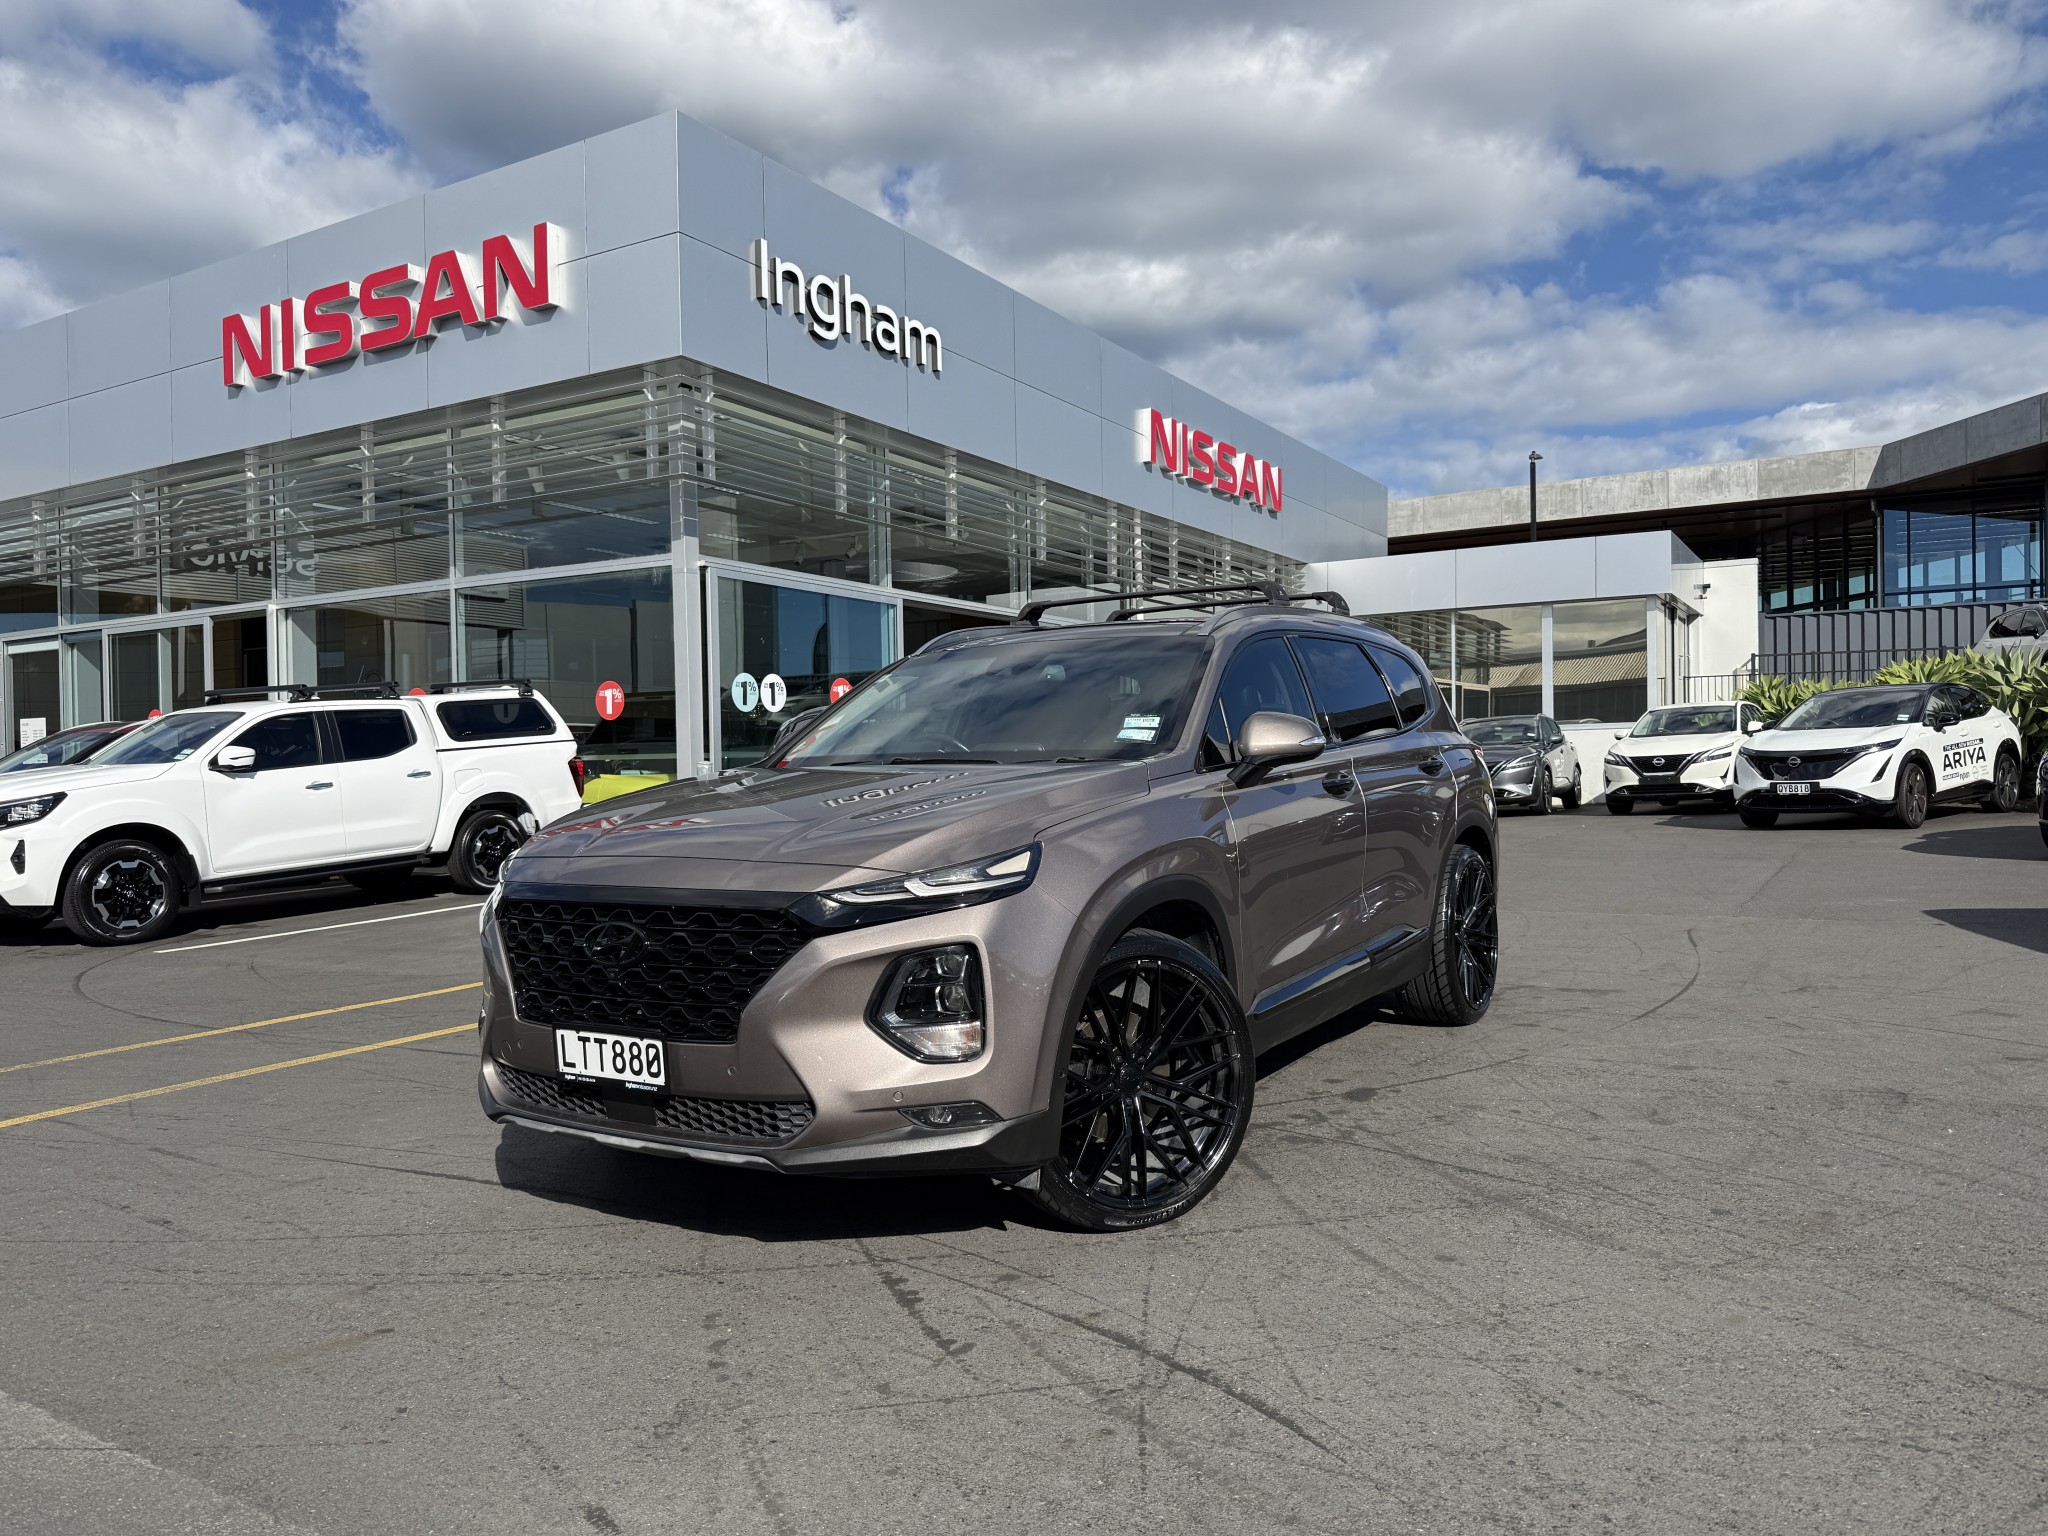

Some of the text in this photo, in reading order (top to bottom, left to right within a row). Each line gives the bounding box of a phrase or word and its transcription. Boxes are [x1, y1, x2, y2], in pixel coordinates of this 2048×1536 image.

[222, 221, 553, 387] NISSAN
[756, 238, 942, 372] Ingham
[1149, 408, 1283, 513] NISSAN
[605, 688, 622, 715] 1%
[741, 681, 757, 706] 1%
[769, 681, 784, 706] 1%
[1943, 746, 1986, 771] ARIYA
[1778, 784, 1809, 793] QYB818
[560, 1033, 662, 1079] LTT880
